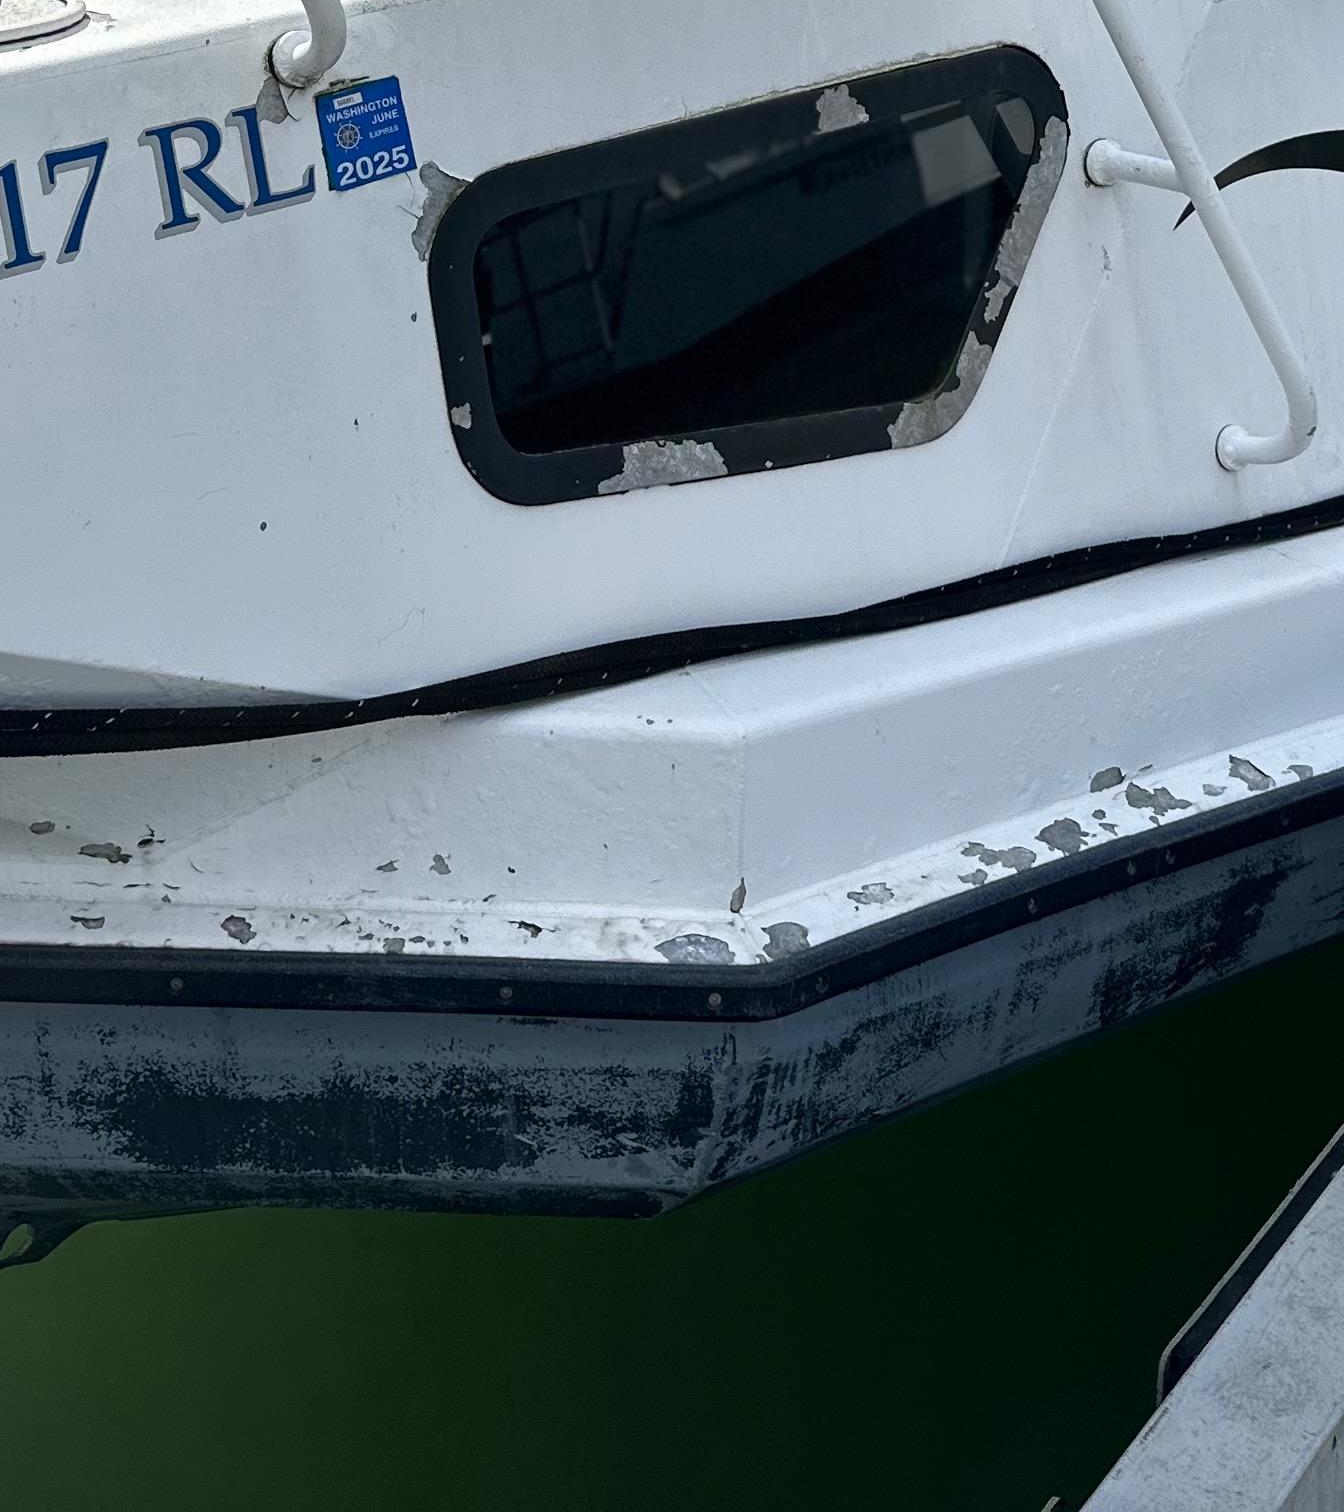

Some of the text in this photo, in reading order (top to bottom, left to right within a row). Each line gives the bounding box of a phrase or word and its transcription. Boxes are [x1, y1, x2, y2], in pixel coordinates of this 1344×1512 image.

[325, 95, 398, 124] WASHINGTON
[371, 108, 400, 125] JUNE
[137, 105, 316, 241] RL
[336, 144, 410, 187] 2025
